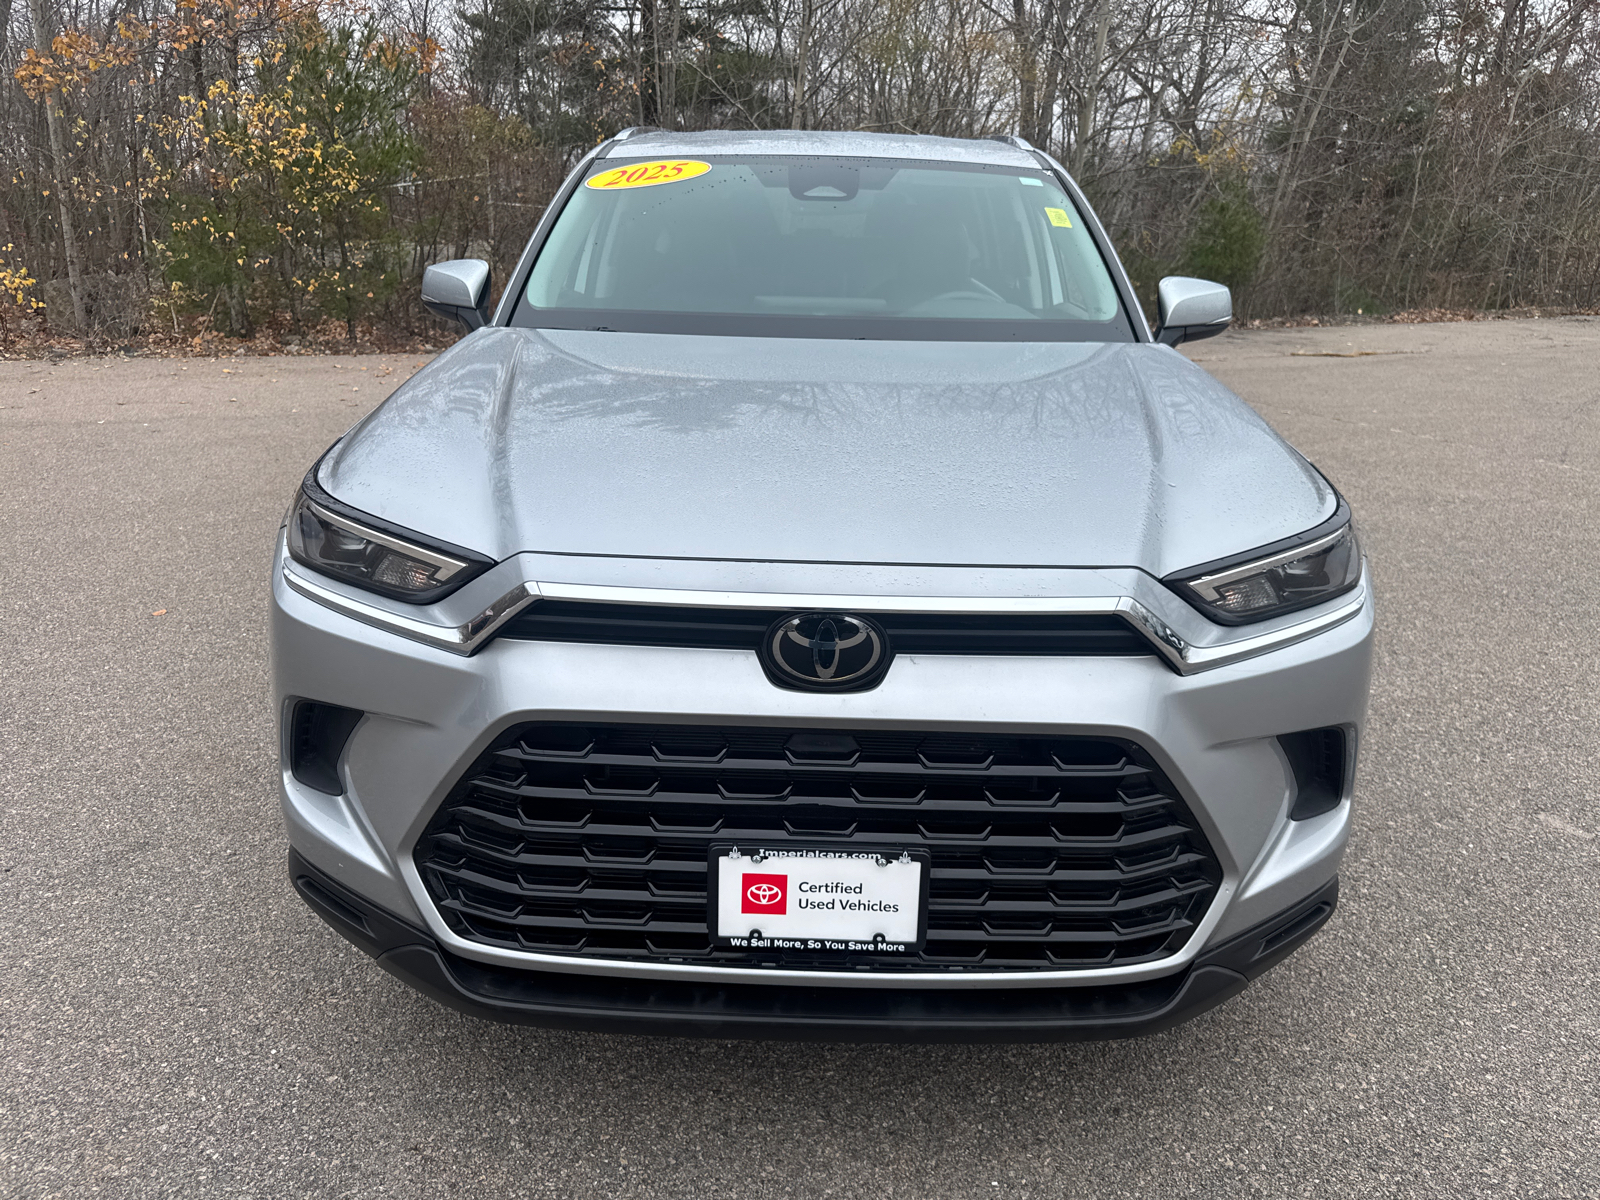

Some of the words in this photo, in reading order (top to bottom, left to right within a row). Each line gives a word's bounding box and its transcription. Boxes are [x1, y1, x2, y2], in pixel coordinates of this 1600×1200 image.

[603, 163, 689, 187] 2025
[759, 849, 881, 860] Imperialcars.com
[798, 881, 863, 894] Certified
[798, 899, 835, 910] Used
[839, 899, 899, 913] Vehicles
[730, 938, 748, 947] We
[751, 938, 771, 947] Sell
[774, 939, 805, 950] More,
[807, 940, 821, 949] So
[824, 941, 845, 950] You
[848, 942, 875, 951] Save
[877, 942, 905, 952] More
